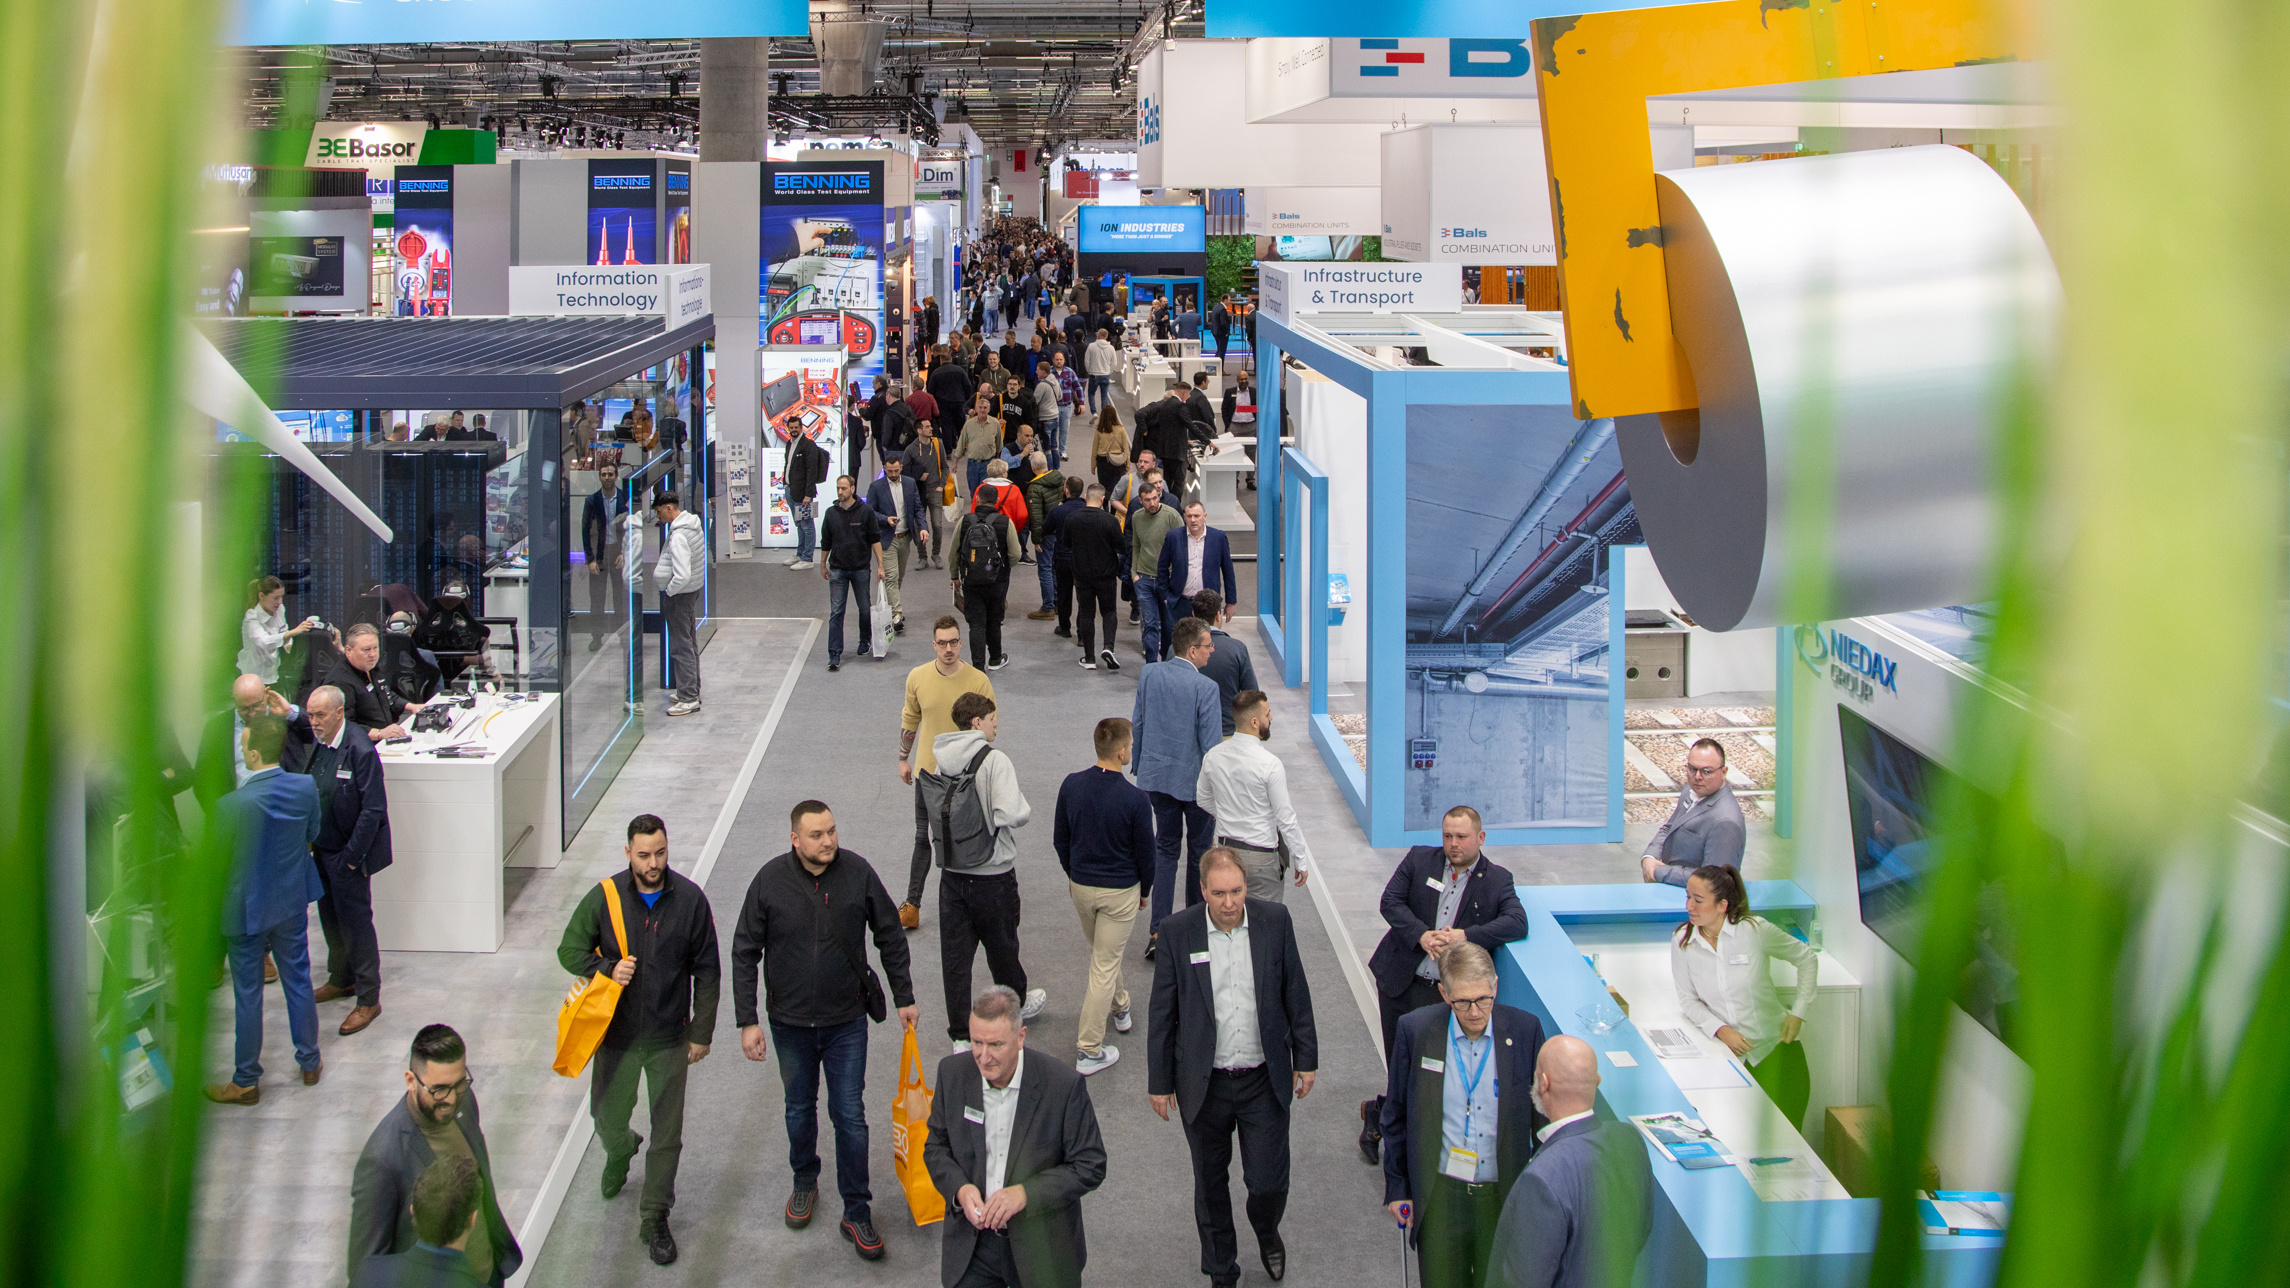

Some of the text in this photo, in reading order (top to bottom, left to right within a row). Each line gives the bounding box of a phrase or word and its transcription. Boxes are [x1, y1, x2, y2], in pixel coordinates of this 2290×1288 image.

[1144, 92, 1160, 145] Bals
[399, 181, 449, 190] BENNING
[594, 177, 651, 187] BENNING
[775, 174, 870, 189] BENNING
[1100, 223, 1185, 233] ION INDUSTRIES
[1453, 228, 1488, 238] Bals
[1441, 244, 1556, 253] COMBINATION UNI
[556, 271, 658, 286] Information
[1303, 268, 1423, 283] Infrastructure
[556, 292, 658, 311] Technology
[1311, 290, 1414, 308] & Transport
[1831, 628, 1897, 693] NIEDAX
[1831, 663, 1874, 701] GROUP
